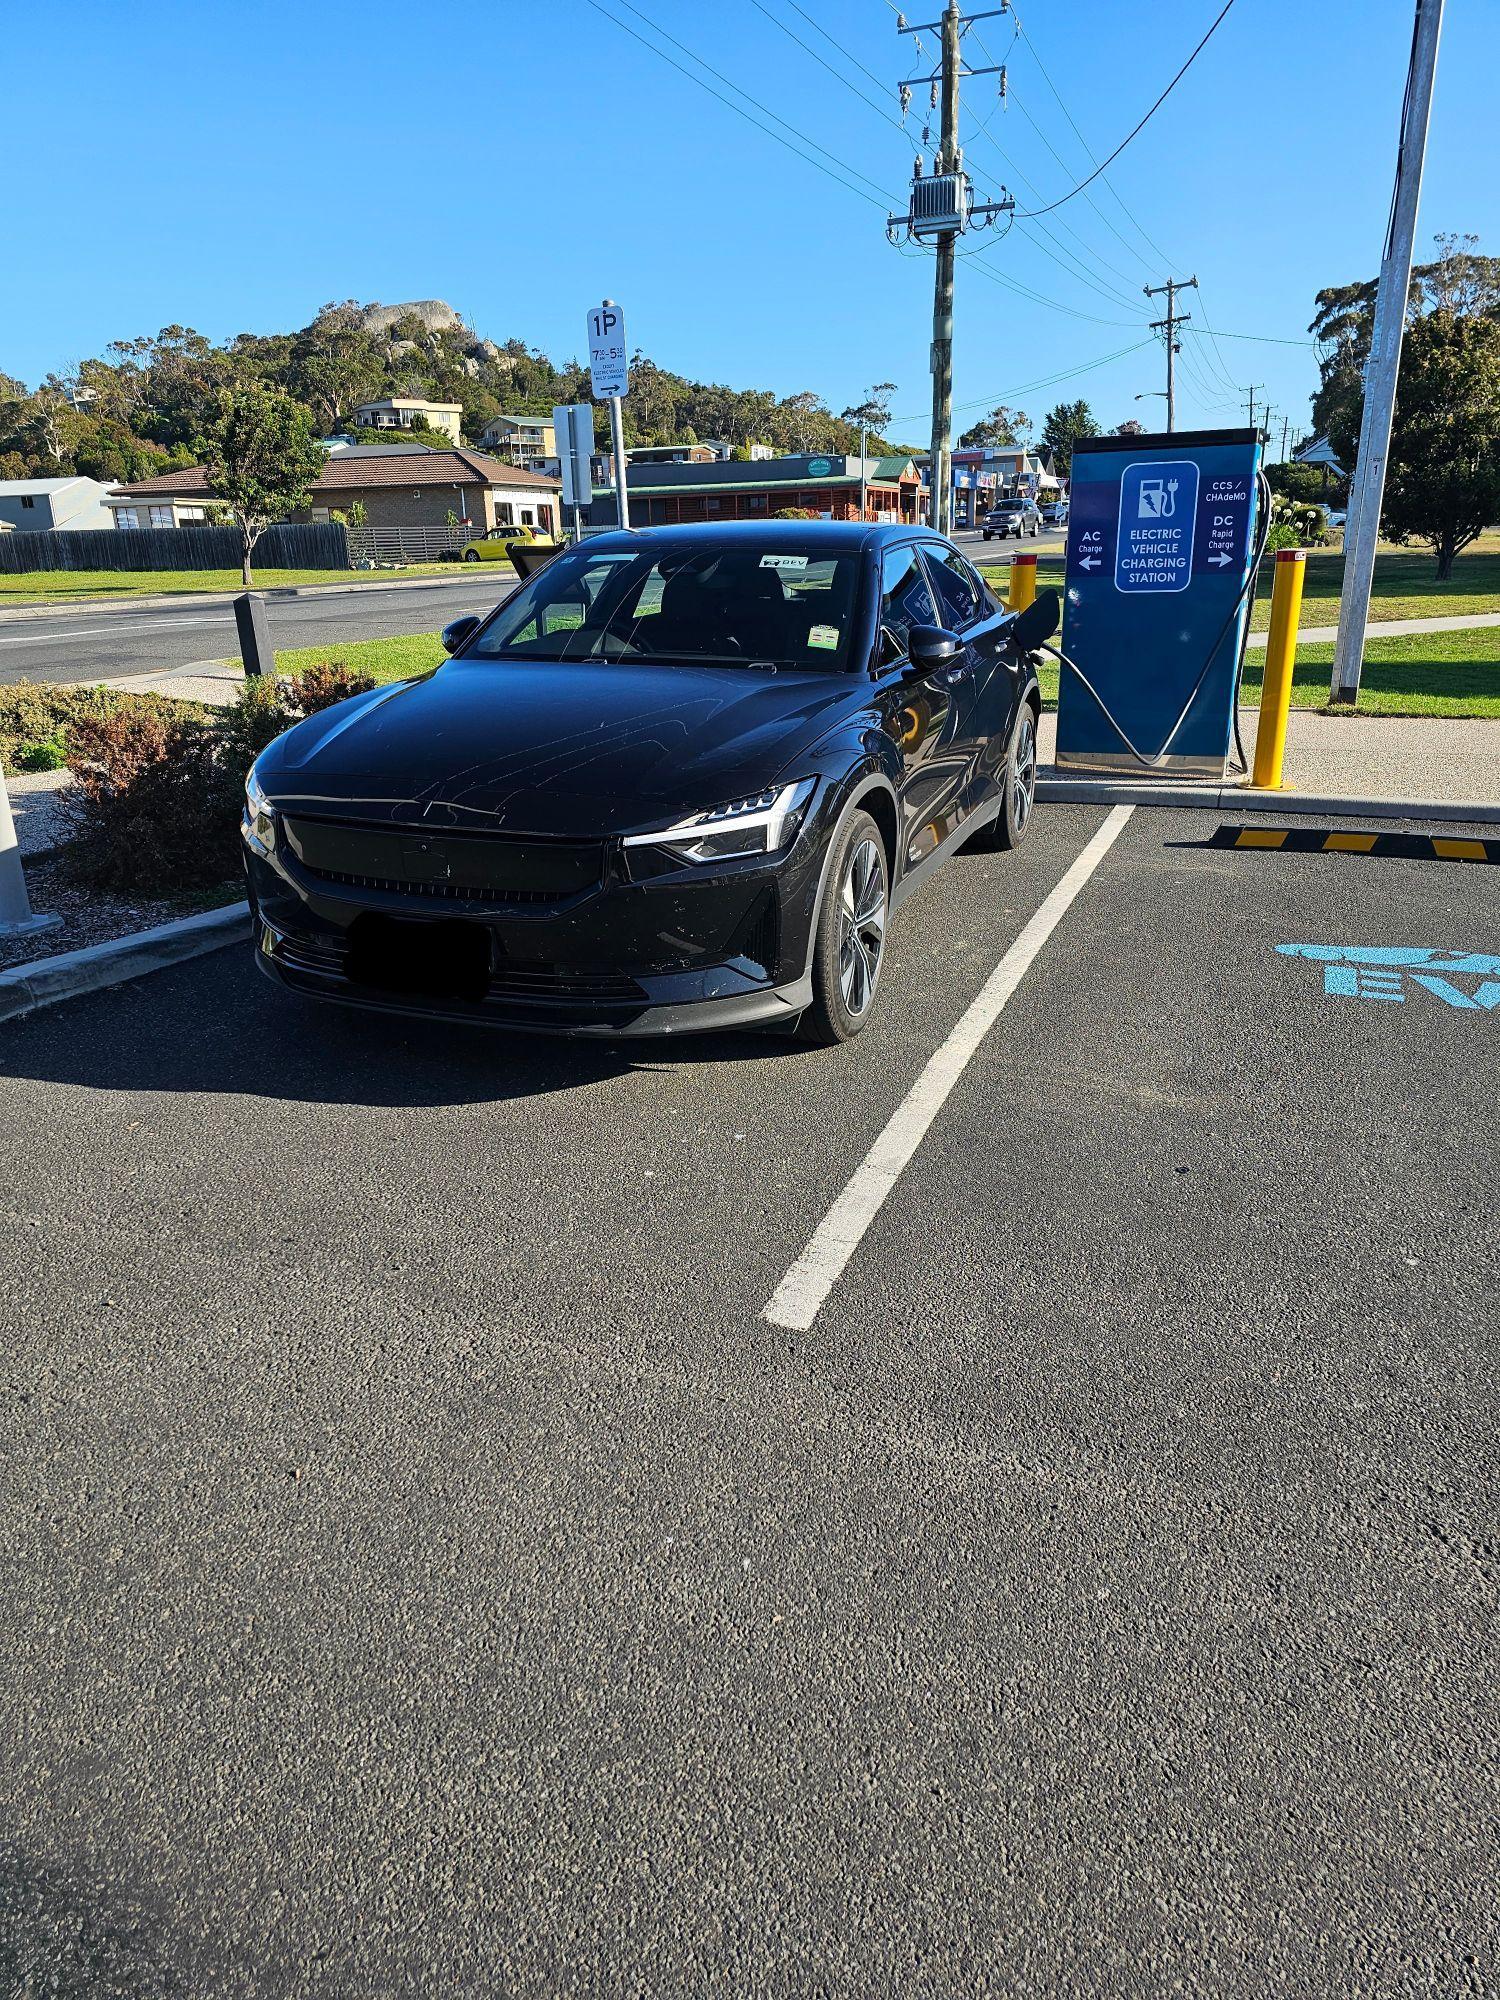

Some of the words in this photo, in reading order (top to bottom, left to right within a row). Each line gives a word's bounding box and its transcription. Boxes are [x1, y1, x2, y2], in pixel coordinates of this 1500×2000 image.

[594, 314, 616, 336] 1P
[1373, 464, 1378, 475] 1
[1212, 481, 1233, 490] CCS
[1205, 491, 1246, 502] CHAdeMO
[1213, 515, 1234, 526] DC
[1081, 531, 1101, 541] AC
[1130, 528, 1182, 540] ELECTRIC
[1211, 529, 1233, 539] Rapid
[1078, 545, 1103, 553] Charge
[1131, 543, 1179, 554] VEHICLE
[1208, 540, 1234, 550] Charge
[1121, 557, 1186, 569] CHARGING
[1128, 572, 1176, 583] STATION
[1323, 965, 1500, 1011] EV
